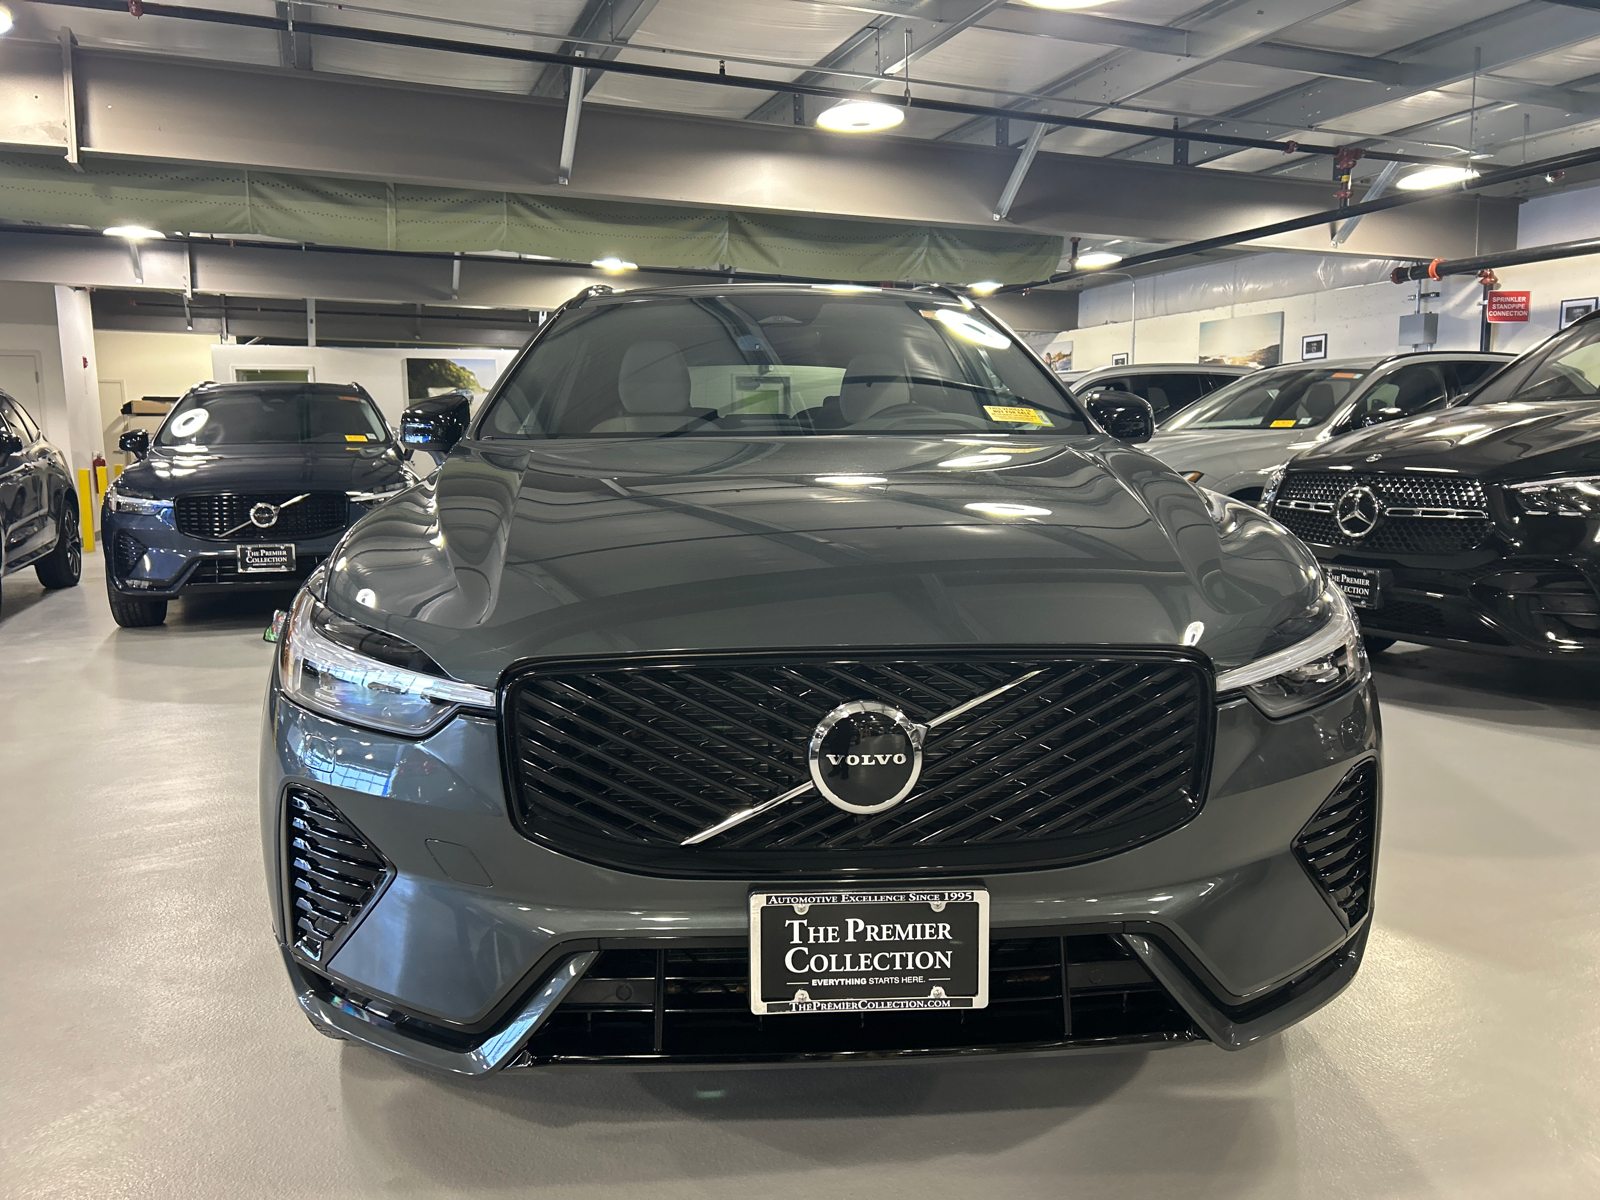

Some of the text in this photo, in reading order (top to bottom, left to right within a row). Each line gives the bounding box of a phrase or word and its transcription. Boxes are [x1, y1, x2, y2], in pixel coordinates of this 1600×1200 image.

[245, 549, 288, 557] THE PREMIER
[245, 556, 288, 564] COLLECTION
[1340, 573, 1371, 587] PREMIER
[826, 753, 907, 766] VOLVO
[768, 891, 973, 905] AUTOMOTIVE EXCELLENCE SINCE 1995
[784, 917, 954, 945] THE PREMIER
[784, 946, 954, 974] COLLECTION
[811, 975, 926, 987] EVERYTHING STARTS HERE.
